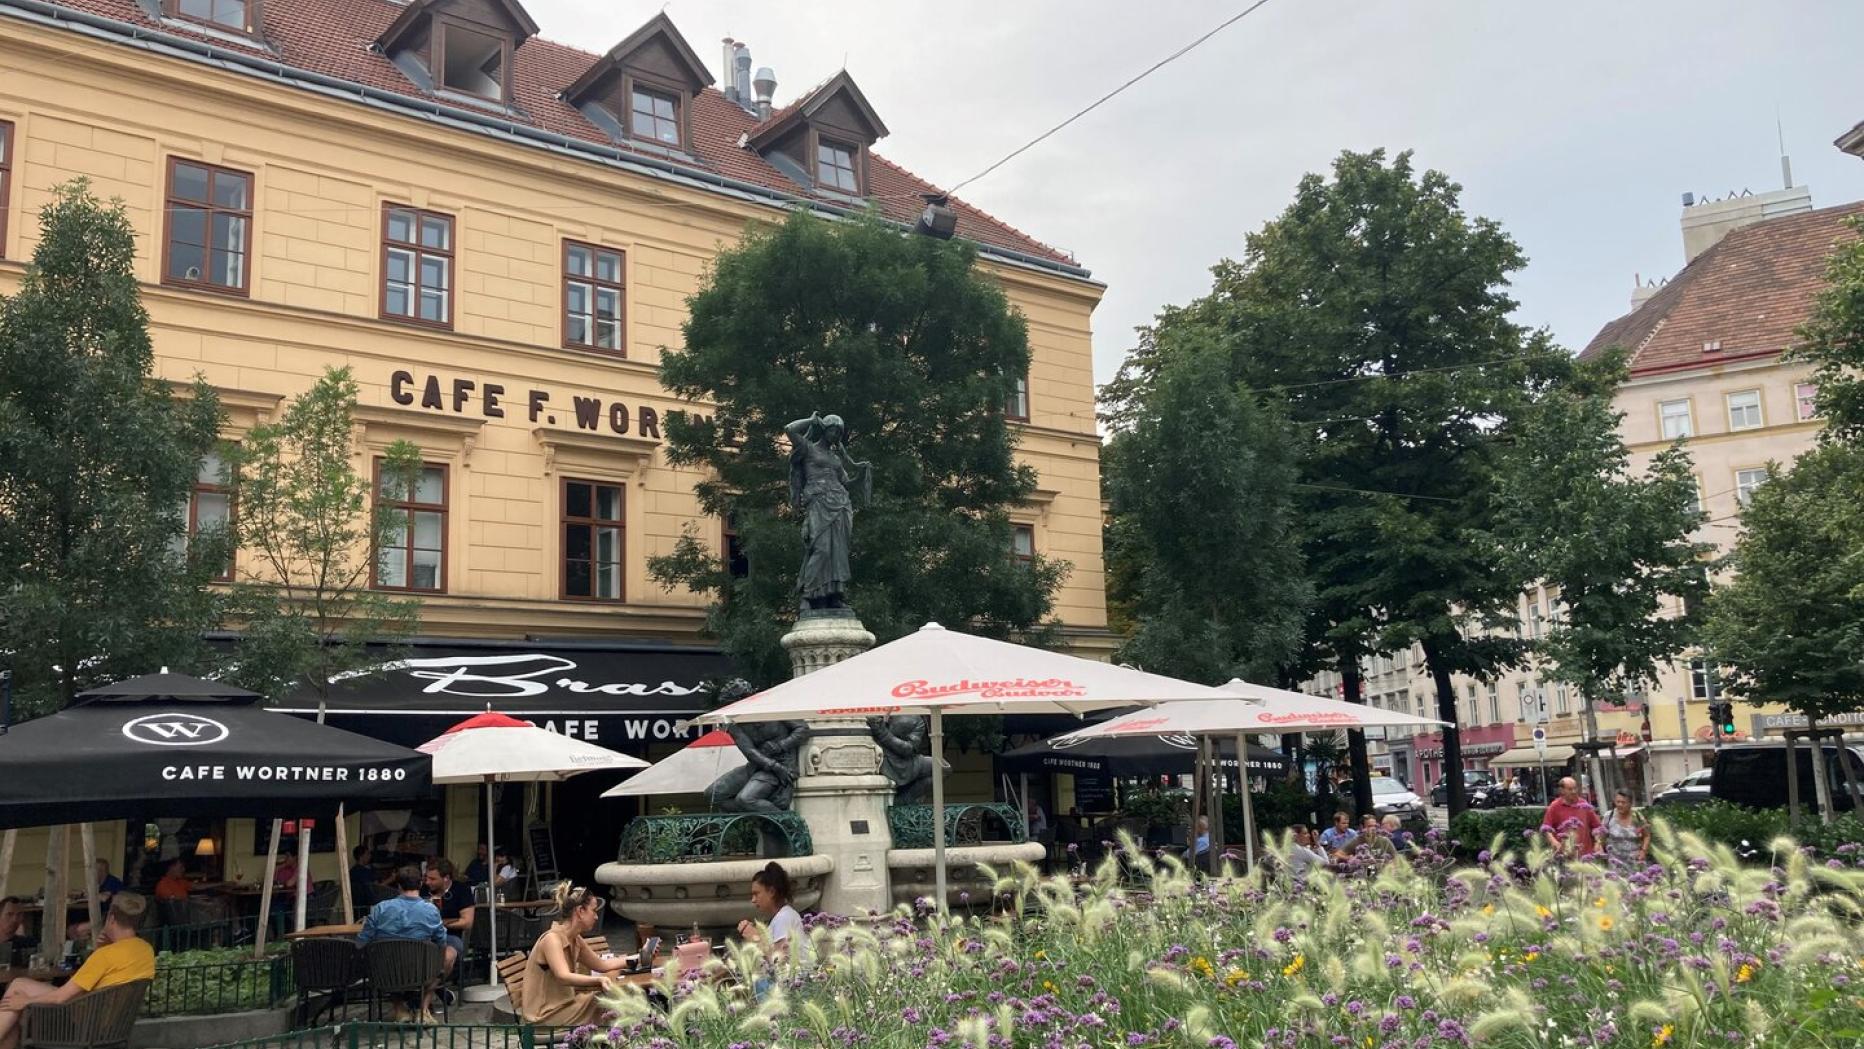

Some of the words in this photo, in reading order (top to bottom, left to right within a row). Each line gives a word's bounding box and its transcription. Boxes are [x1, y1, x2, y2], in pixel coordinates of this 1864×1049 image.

[391, 370, 505, 418] CAFE
[529, 389, 556, 425] F.
[161, 765, 225, 781] CAFE
[235, 766, 349, 781] WORTNER
[358, 767, 406, 781] 1880
